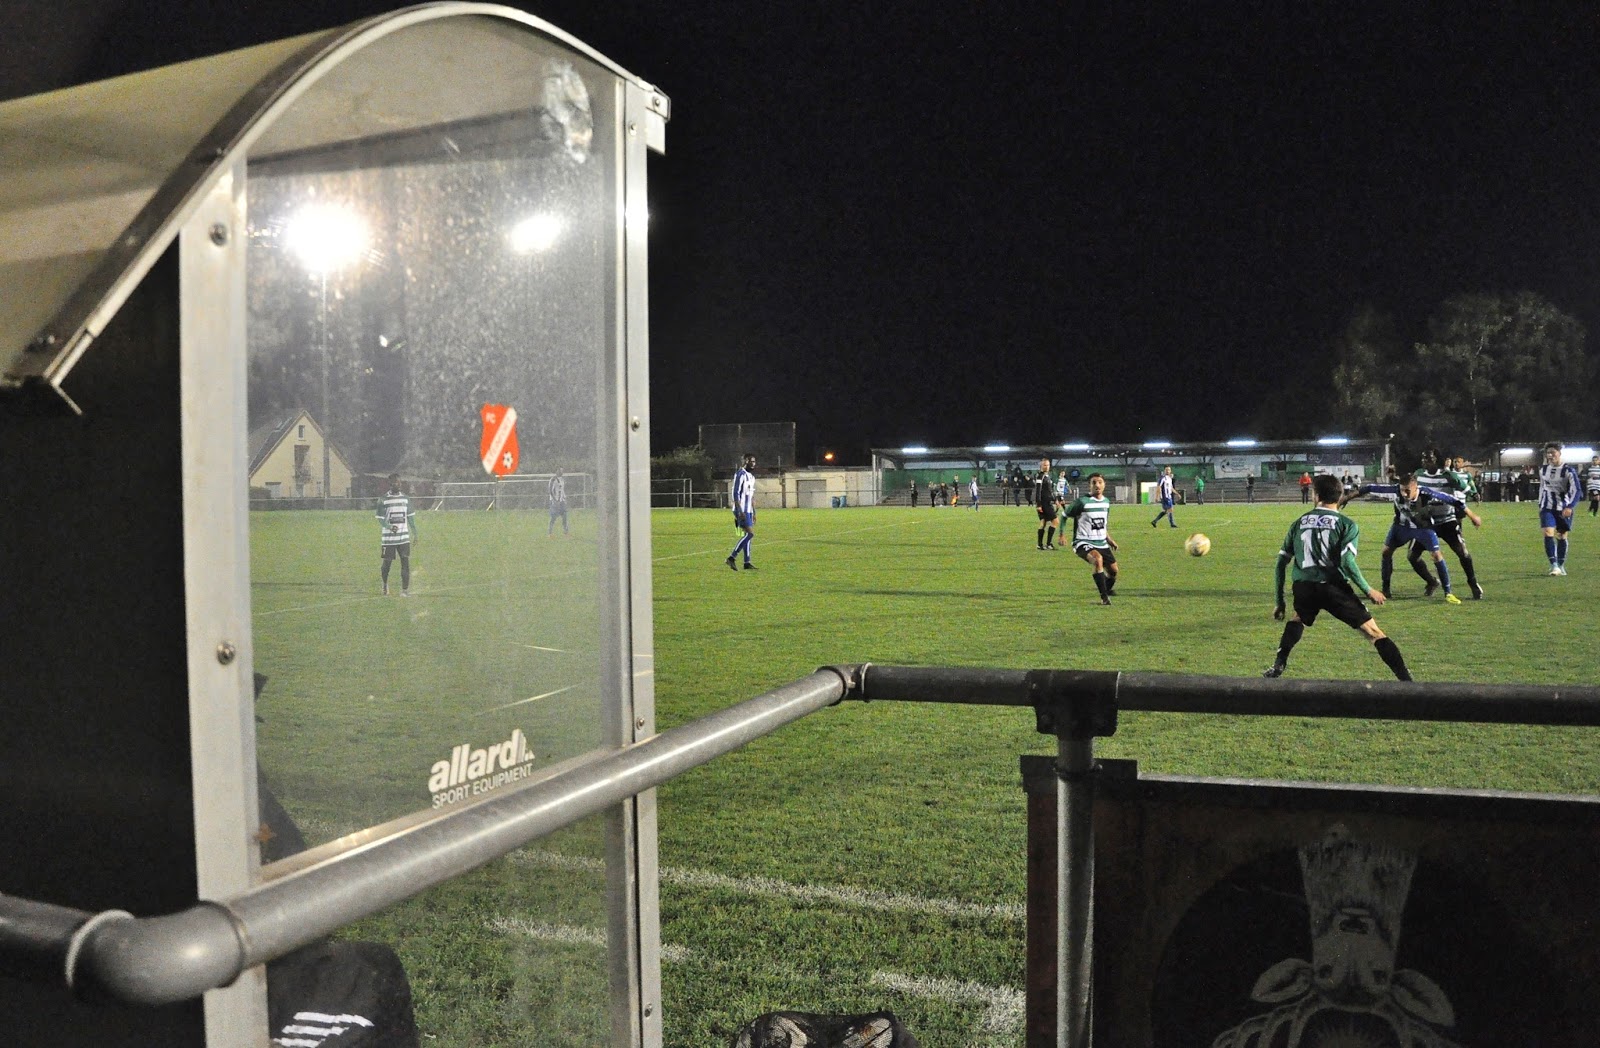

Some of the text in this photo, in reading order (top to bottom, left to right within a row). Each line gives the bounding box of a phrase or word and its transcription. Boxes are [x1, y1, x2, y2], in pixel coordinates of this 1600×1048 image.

[1300, 529, 1331, 568] 11
[428, 728, 521, 793] allard
[431, 763, 534, 810] SPORT EQUIPMENT
